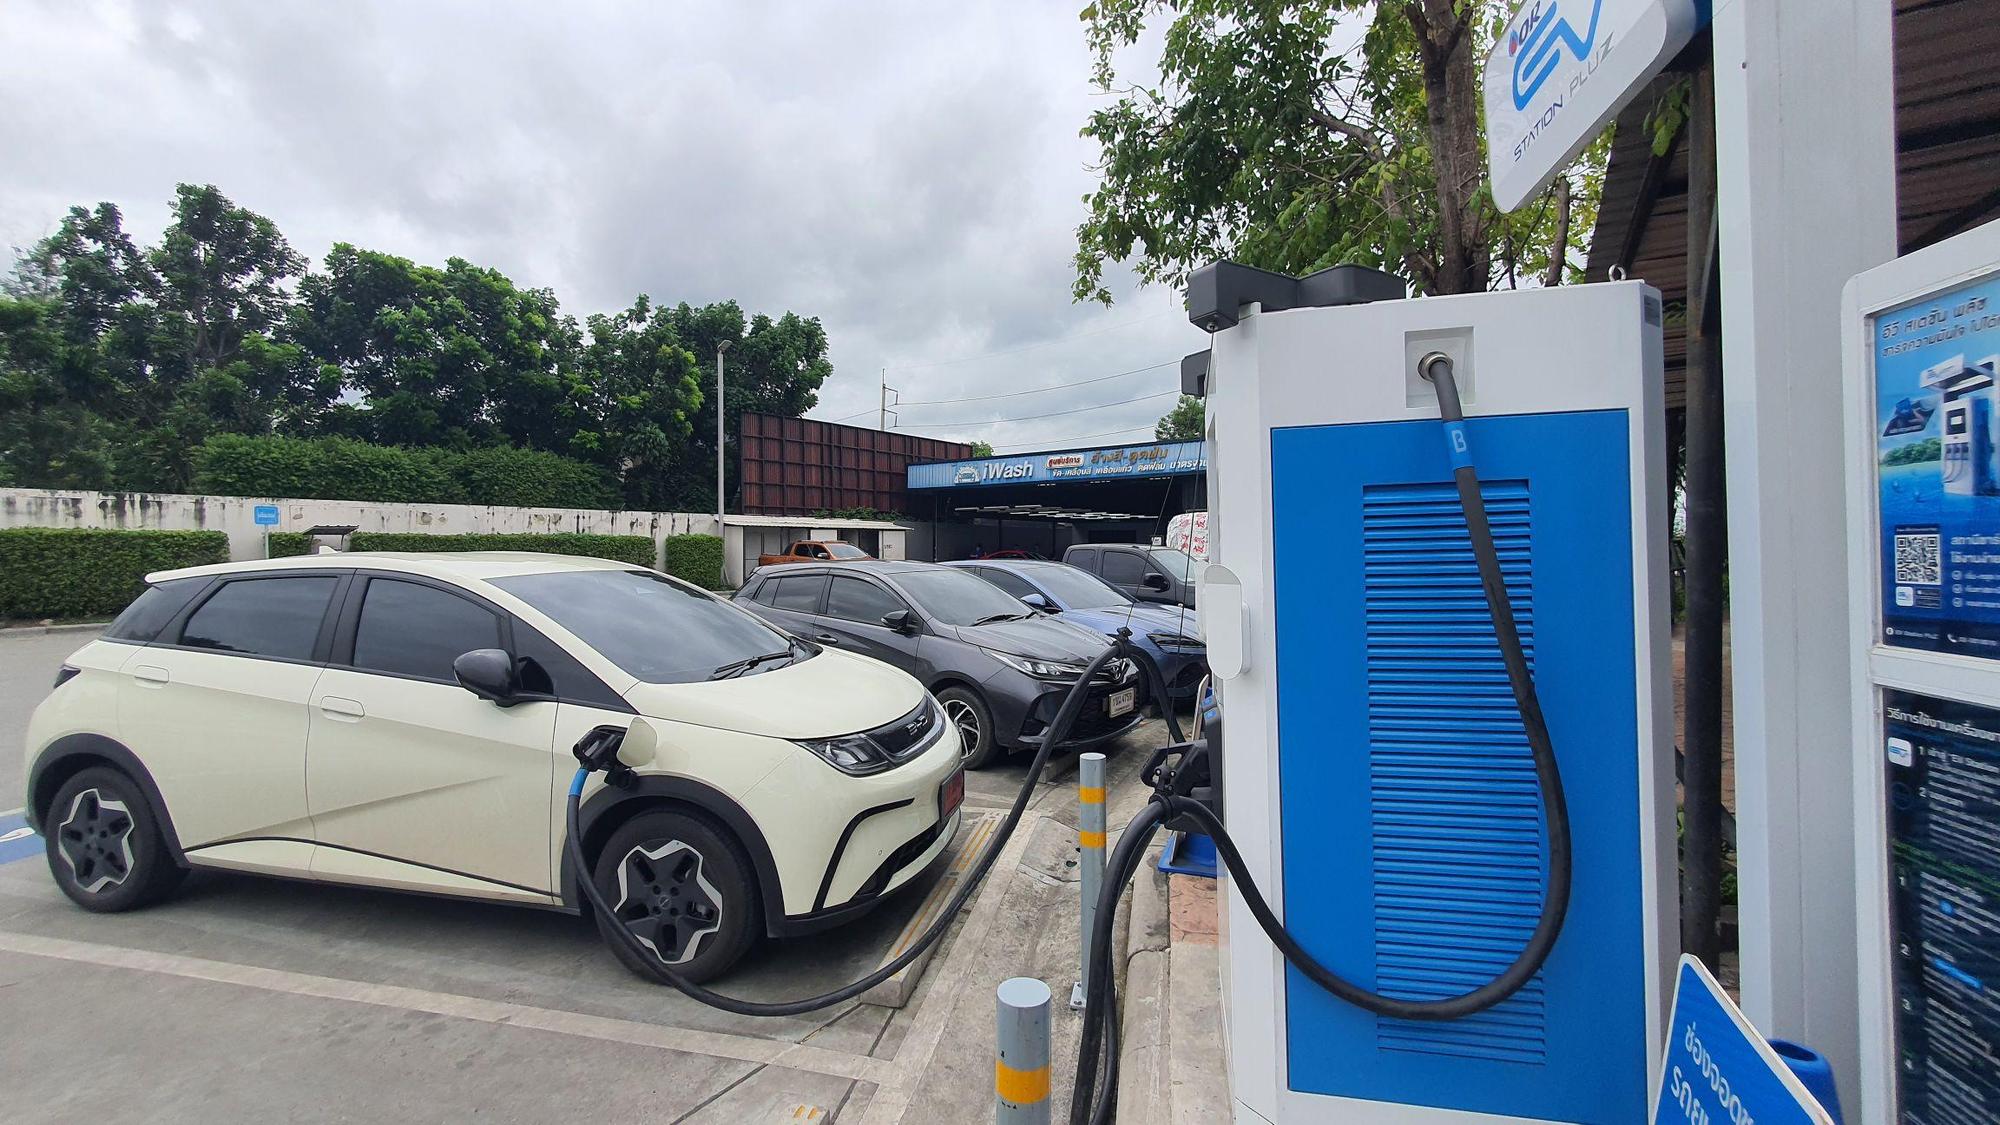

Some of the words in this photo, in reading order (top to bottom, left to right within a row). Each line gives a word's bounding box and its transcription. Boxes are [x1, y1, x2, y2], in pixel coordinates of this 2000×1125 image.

[1519, 1, 1541, 46] OR
[1514, 94, 1563, 162] STATION
[1569, 31, 1615, 98] PLUZ
[1451, 429, 1467, 453] B
[982, 460, 1034, 481] iWash
